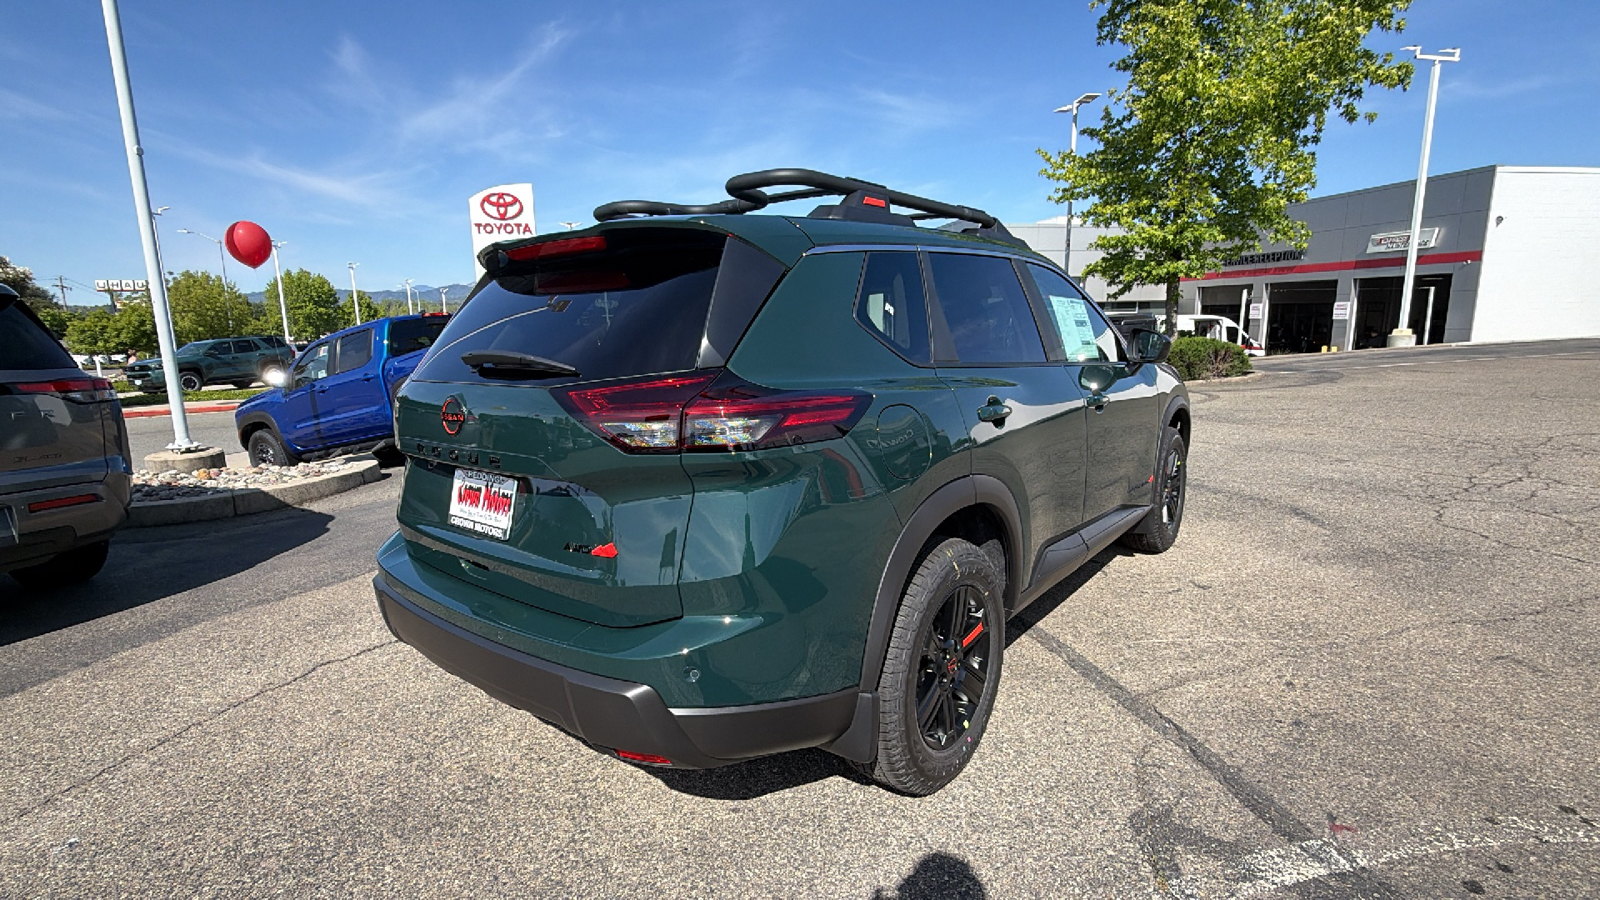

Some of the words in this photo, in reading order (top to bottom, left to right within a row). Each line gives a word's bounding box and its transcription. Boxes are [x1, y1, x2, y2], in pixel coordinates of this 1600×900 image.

[474, 223, 533, 235] TOYOTA
[96, 281, 146, 289] UHAU
[481, 482, 512, 517] Motors
[450, 516, 475, 530] CROWN
[474, 522, 503, 538] MOTORS
